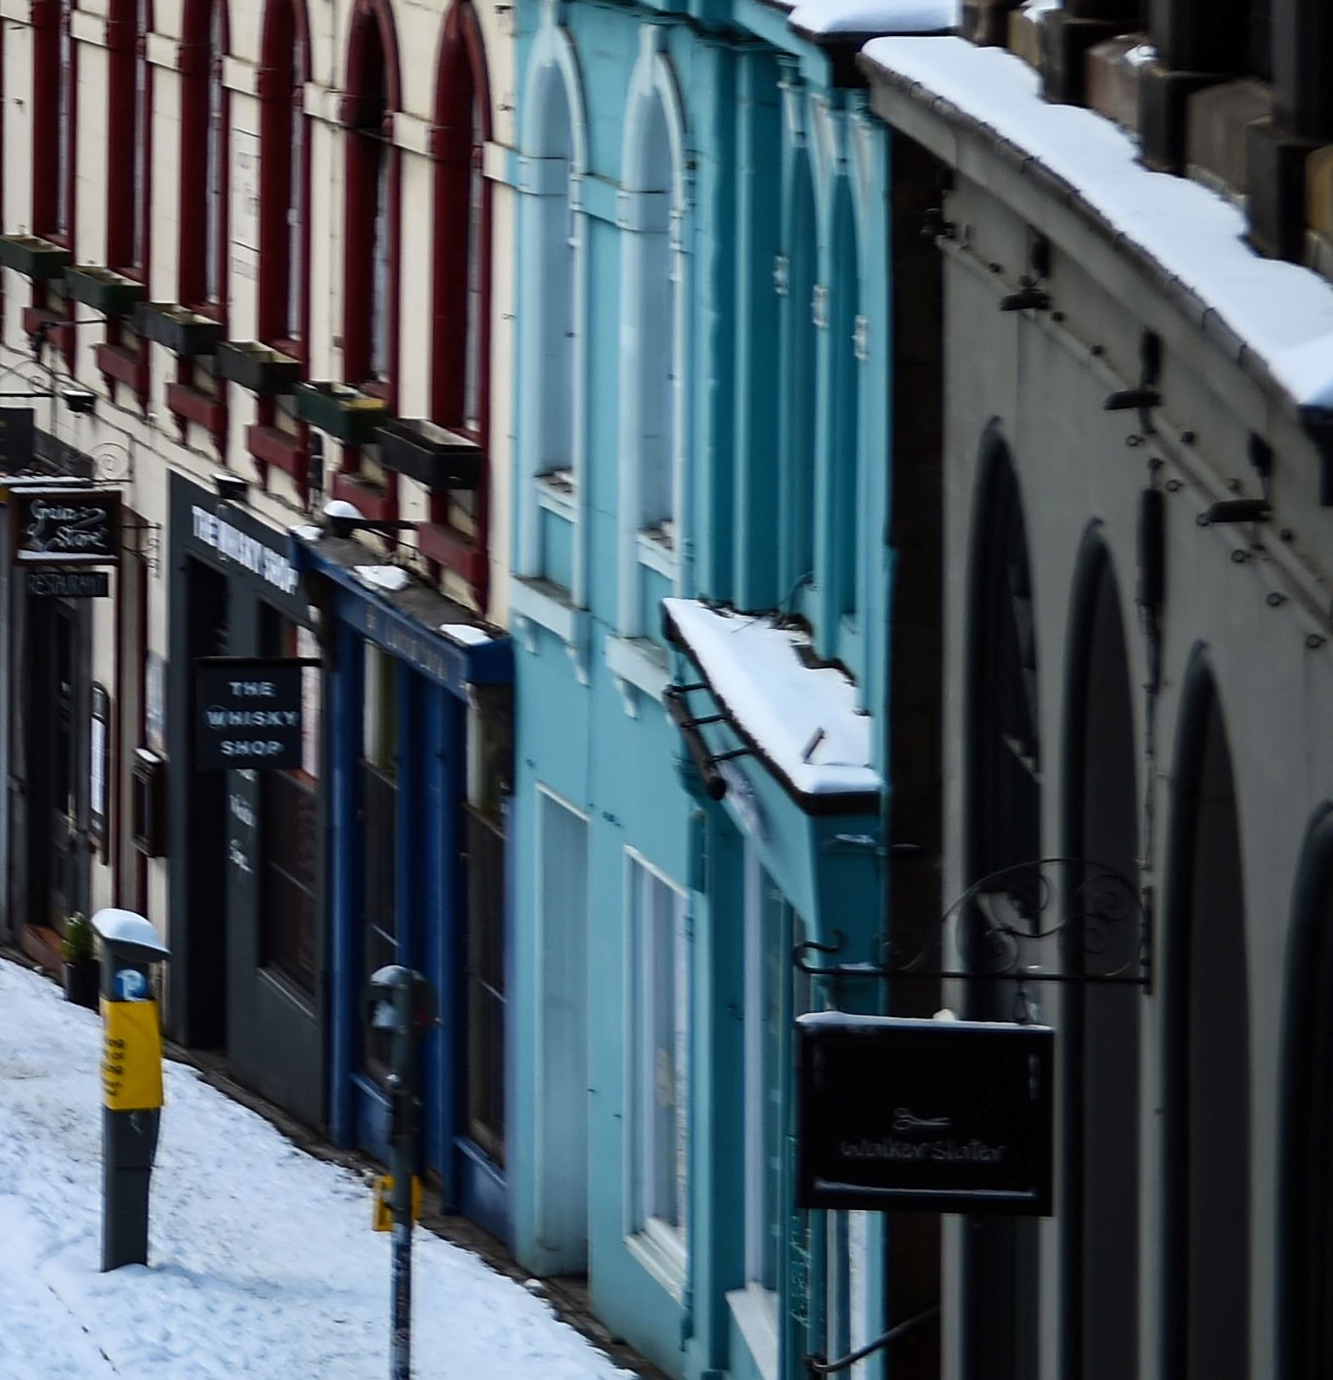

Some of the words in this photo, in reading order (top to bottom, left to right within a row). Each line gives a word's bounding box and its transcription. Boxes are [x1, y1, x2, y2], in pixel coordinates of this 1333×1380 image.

[191, 505, 218, 548] THE
[217, 518, 263, 574] WHISKY
[263, 546, 299, 595] SHOP
[228, 681, 277, 698] THE
[205, 710, 301, 727] WHISKY
[219, 740, 285, 757] SHOP
